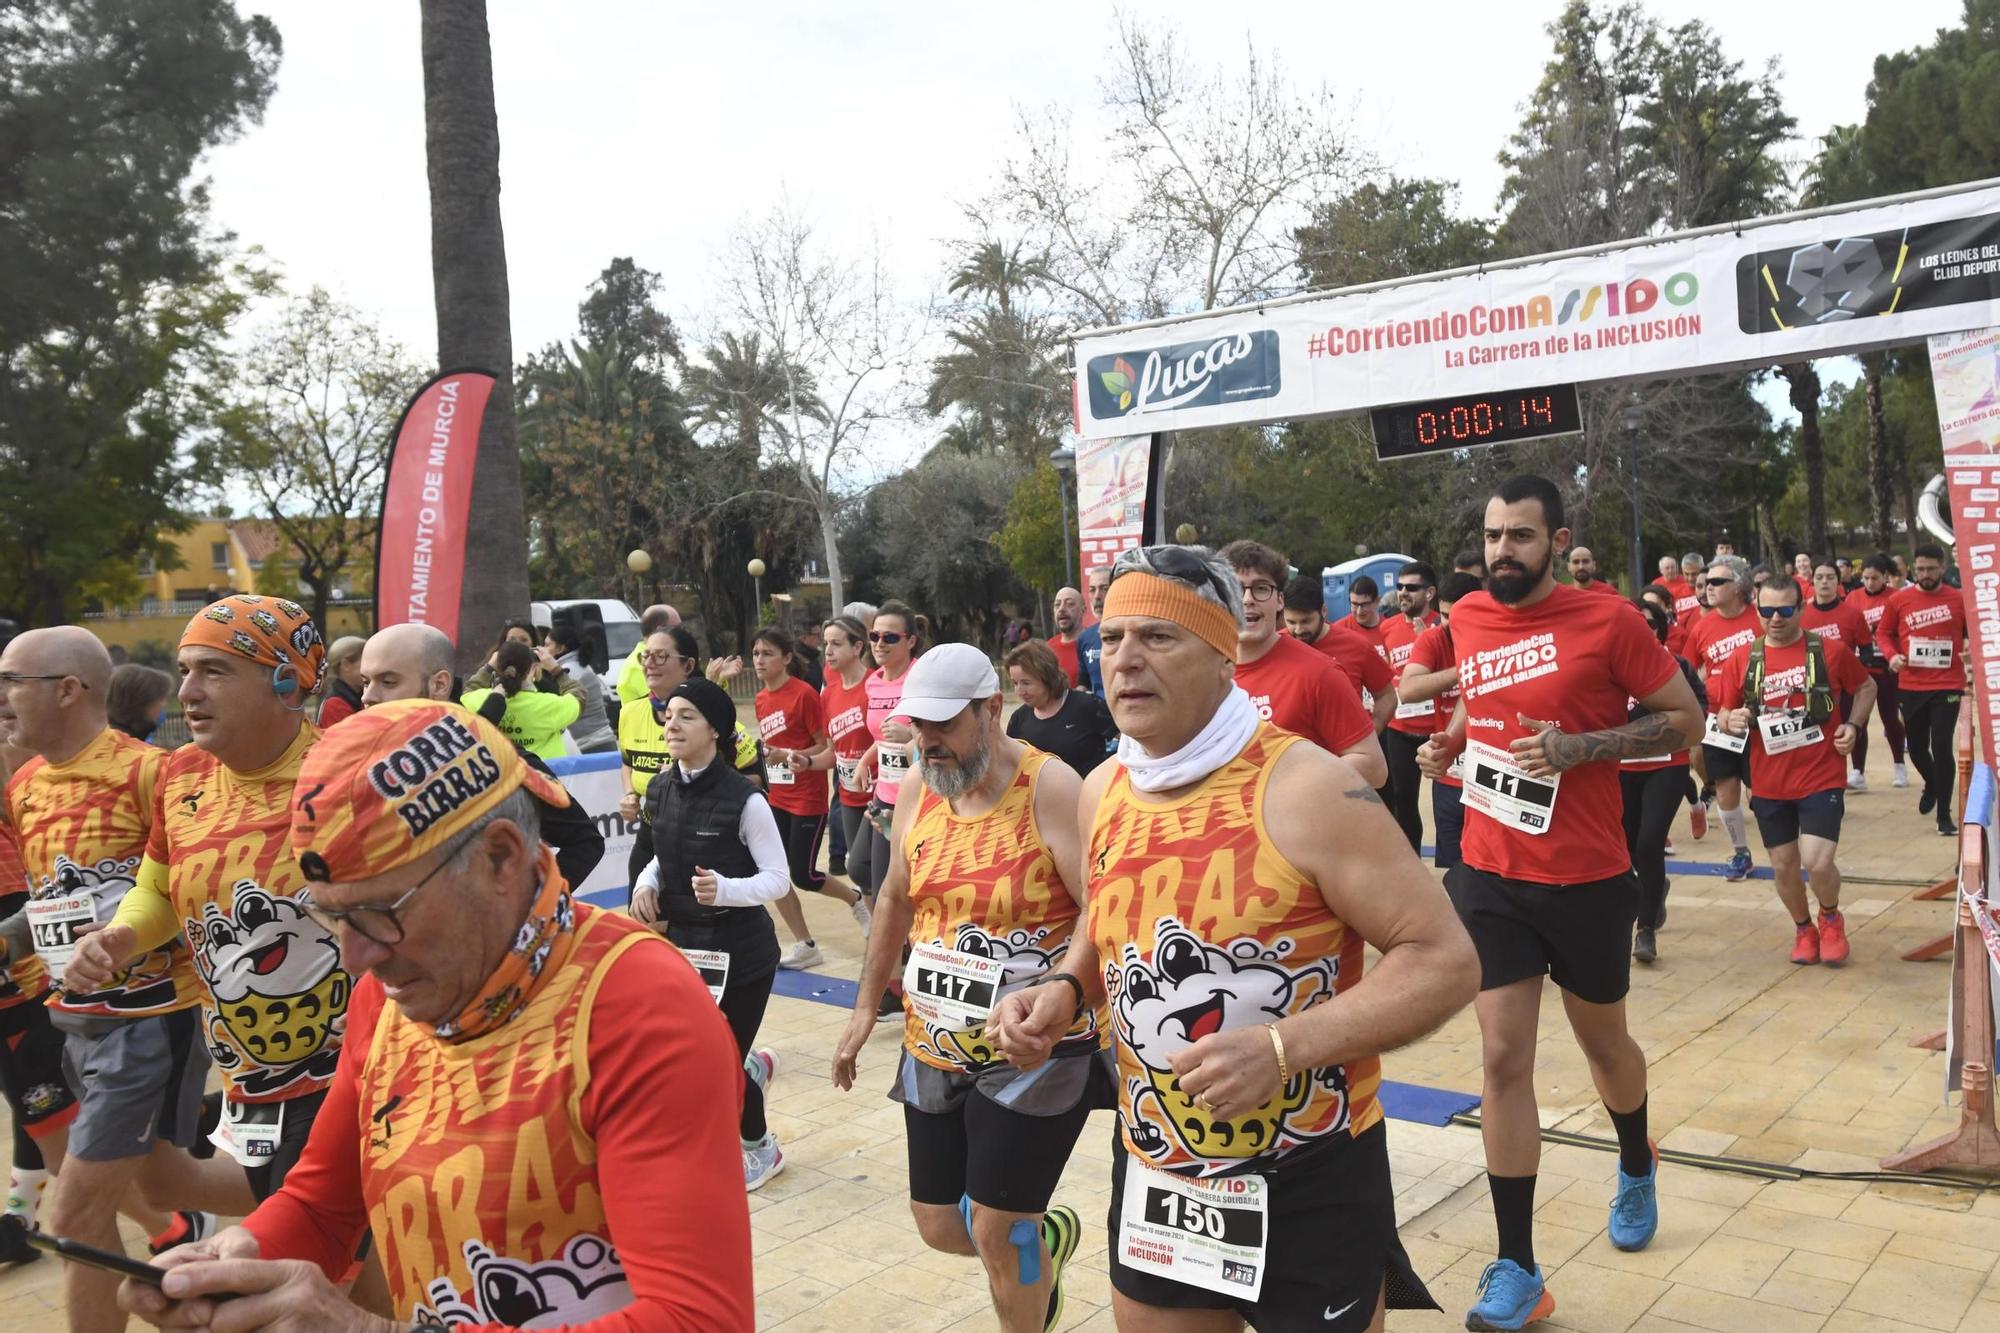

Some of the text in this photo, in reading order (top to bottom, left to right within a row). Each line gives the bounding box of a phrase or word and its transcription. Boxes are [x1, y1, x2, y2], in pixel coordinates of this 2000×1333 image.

[1920, 244, 2000, 269] LOS LEONES DEL
[1934, 265, 1961, 281] CLUB
[1445, 313, 1702, 369] La Carrera de la INCLUSIÓN
[1126, 331, 1253, 417] Lucas
[428, 381, 460, 467] MURCIA
[422, 471, 443, 502] DE
[1969, 544, 1996, 570] La
[1480, 644, 1557, 681] ASSIDO
[1476, 675, 1514, 696] CARRERA
[1513, 661, 1559, 684] SOLIDARIA
[369, 715, 478, 799] CORRE
[632, 755, 659, 769] LATAS
[886, 756, 901, 767] 34
[397, 746, 500, 838] BIRRAS
[1491, 772, 1520, 798] 11
[37, 922, 70, 947] 141
[926, 971, 972, 1002] 117
[1222, 1196, 1260, 1206] SOLIDARIA
[1161, 1193, 1225, 1240] 150
[1128, 1246, 1173, 1266] INCLUSIÓN
[1136, 1237, 1158, 1250] Carrera
[1158, 1243, 1168, 1252] de
[1168, 1245, 1175, 1253] la
